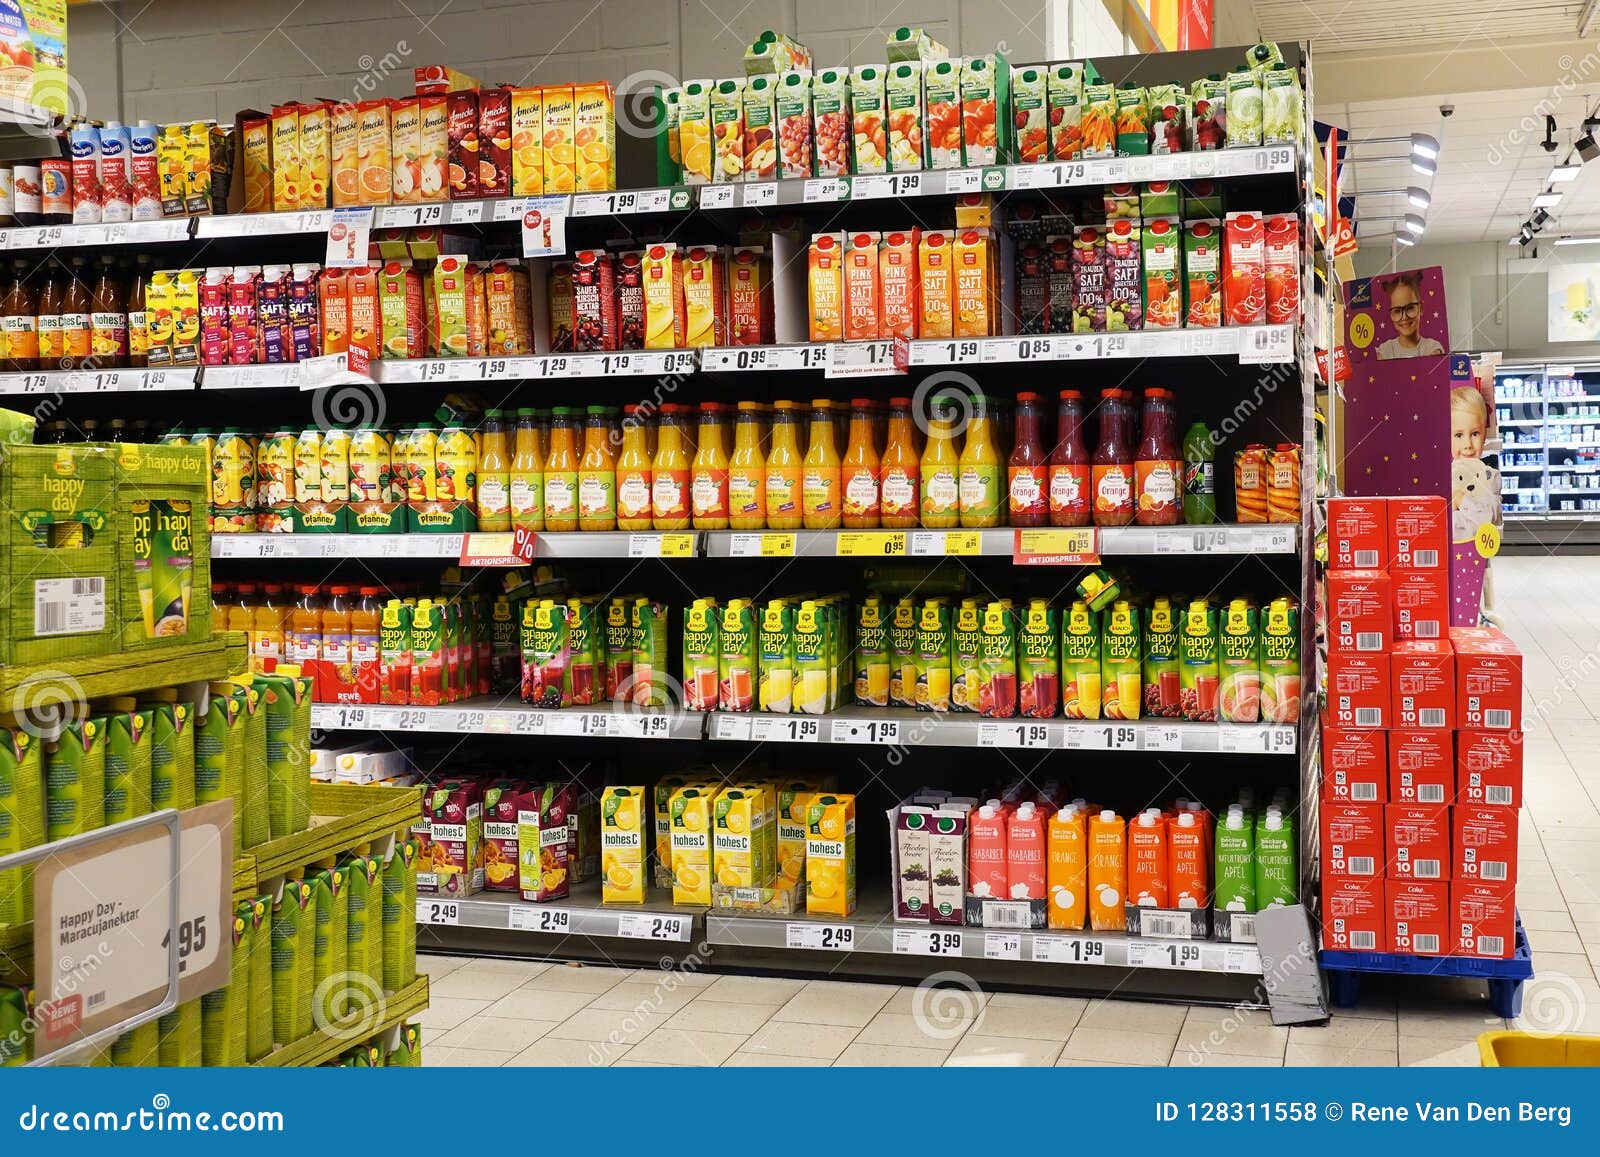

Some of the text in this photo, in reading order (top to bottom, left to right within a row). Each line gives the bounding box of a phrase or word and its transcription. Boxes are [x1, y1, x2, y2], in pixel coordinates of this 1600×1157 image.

[514, 105, 540, 118] Amecke
[545, 102, 572, 116] Amecke
[577, 99, 604, 114] Amecke
[274, 124, 297, 139] Amecke
[359, 118, 384, 133] Amecke
[393, 118, 419, 132] Amecke
[1256, 151, 1290, 170] 0.99
[1052, 164, 1084, 184] 1.79
[888, 176, 919, 194] 1.99
[606, 194, 635, 213] 1.99
[414, 206, 440, 224] 1.79
[851, 269, 872, 279] PINK
[884, 267, 906, 278] PINK
[1115, 268, 1138, 281] SAFT
[924, 278, 947, 289] SAFT
[960, 277, 981, 288] SAFT
[1081, 274, 1104, 286] SAFT
[851, 287, 872, 298] SAFT
[884, 284, 907, 296] SAFT
[734, 293, 754, 302] SAFT
[202, 306, 223, 317] SAFT
[228, 305, 251, 315] SAFT
[260, 304, 284, 315] SAFT
[289, 303, 313, 313] SAFT
[946, 342, 977, 362] 1.59
[1019, 340, 1050, 359] 0.85
[1092, 337, 1125, 357] 1.29
[664, 354, 692, 372] 0.99
[737, 350, 765, 369] 0.99
[1318, 350, 1345, 364] RWE
[419, 363, 445, 380] 1.59
[478, 361, 505, 378] 1.59
[539, 358, 566, 376] 1.29
[601, 357, 629, 374] 1.19
[23, 375, 46, 392] 1.79
[96, 374, 119, 390] 1.79
[141, 372, 166, 388] 1.89
[147, 453, 201, 473] happy day
[43, 474, 85, 498] happy
[1012, 486, 1036, 498] Orange
[1051, 486, 1074, 497] Orange
[1101, 486, 1127, 497] Orange
[52, 495, 78, 516] day
[516, 529, 533, 558] %
[884, 541, 904, 554] 0.95
[1068, 539, 1089, 553] 0.95
[1192, 531, 1226, 552] 0.79
[1028, 555, 1081, 565] AKTIONSPREIS
[1338, 554, 1352, 563] 10
[1397, 553, 1411, 562] 10
[1399, 624, 1412, 633] 10
[861, 637, 880, 648] day
[916, 629, 946, 643] happy
[979, 633, 1010, 648] happy
[1021, 632, 1053, 647] happy
[1064, 633, 1096, 648] happy
[1105, 633, 1137, 648] happy
[1146, 631, 1178, 646] happy
[1181, 635, 1215, 650] happy
[1221, 634, 1255, 649] happy
[1262, 633, 1296, 649] happy
[1339, 636, 1353, 645] 10
[688, 642, 707, 654] day
[724, 642, 742, 654] day
[764, 641, 783, 653] day
[797, 642, 816, 654] day
[921, 640, 941, 653] day
[984, 645, 1004, 658] day
[1027, 645, 1048, 657] day
[1070, 645, 1090, 658] day
[1111, 645, 1132, 658] day
[1151, 643, 1172, 656] day
[1187, 647, 1210, 660] day
[1228, 646, 1249, 659] day
[1268, 646, 1290, 659] day
[338, 710, 364, 727] 1.49
[516, 714, 544, 731] 2.29
[1338, 711, 1352, 721] 10
[1401, 712, 1415, 721] 10
[1466, 712, 1481, 722] 10
[580, 715, 606, 733] 1.95
[639, 717, 667, 735] 1.95
[788, 721, 817, 740] 1.95
[867, 723, 897, 742] 1.95
[1015, 726, 1047, 746] 1.95
[1102, 727, 1135, 748] 1.95
[1259, 730, 1293, 751] 1.95
[1334, 786, 1348, 795] 10
[1400, 788, 1414, 797] 10
[1468, 788, 1482, 798] 10
[1094, 855, 1123, 868] ORANGE
[1331, 860, 1345, 869] 10
[1396, 863, 1410, 872] 10
[1224, 866, 1246, 879] APFEL
[1264, 868, 1286, 881] APFEL
[60, 909, 94, 930] Happy
[96, 901, 116, 918] Day
[430, 904, 457, 923] 2.49
[541, 911, 568, 930] 2.49
[60, 908, 140, 946] Maracujanektar
[651, 918, 680, 937] 2.49
[822, 928, 852, 948] 2.49
[929, 933, 961, 953] 3.99
[1070, 941, 1103, 961] 1.99
[1167, 945, 1199, 966] 1.99
